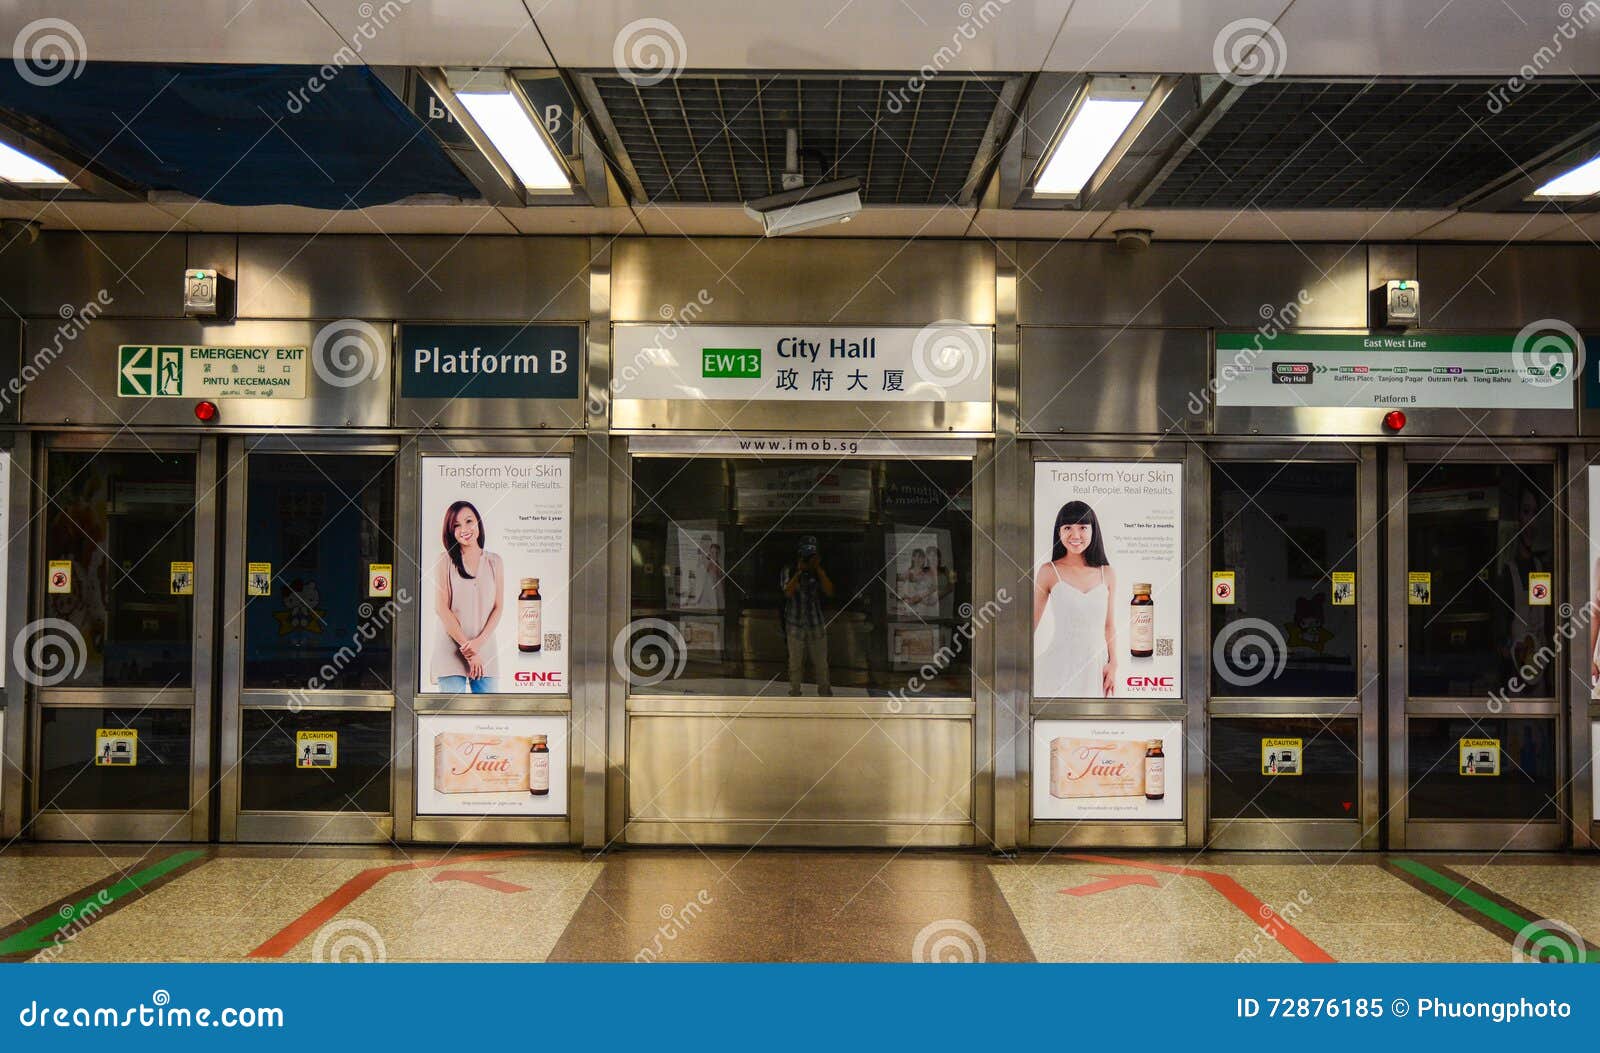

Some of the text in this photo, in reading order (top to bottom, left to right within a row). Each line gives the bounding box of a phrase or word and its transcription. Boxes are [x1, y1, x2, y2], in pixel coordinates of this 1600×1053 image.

[192, 284, 209, 297] 20
[1397, 295, 1409, 308] 19
[776, 336, 876, 362] City Hall
[1363, 338, 1427, 348] East West Line
[190, 348, 305, 360] EMERGENCY EXIT
[414, 346, 568, 374] Platform B
[704, 353, 760, 373] EW13
[1555, 366, 1563, 376] 2
[203, 377, 291, 386] PINTU KECEMASAN
[775, 368, 905, 392] 政府大厦
[1279, 375, 1307, 384] City Hall
[1378, 375, 1423, 383] Tanjong Pagar
[1473, 376, 1491, 384] Tiong
[1374, 394, 1417, 403] Platform B
[739, 439, 858, 454] www.imob.sg
[438, 463, 562, 477] Transform Your Skin
[1050, 468, 1174, 483] Transform Your Skin
[460, 480, 563, 491] Real People. Real Results.
[1072, 486, 1174, 496] Real People. Real Results.
[514, 671, 562, 682] GNC
[1126, 676, 1174, 687] GNC
[451, 740, 511, 776] Taut
[1066, 743, 1126, 781] Taut
